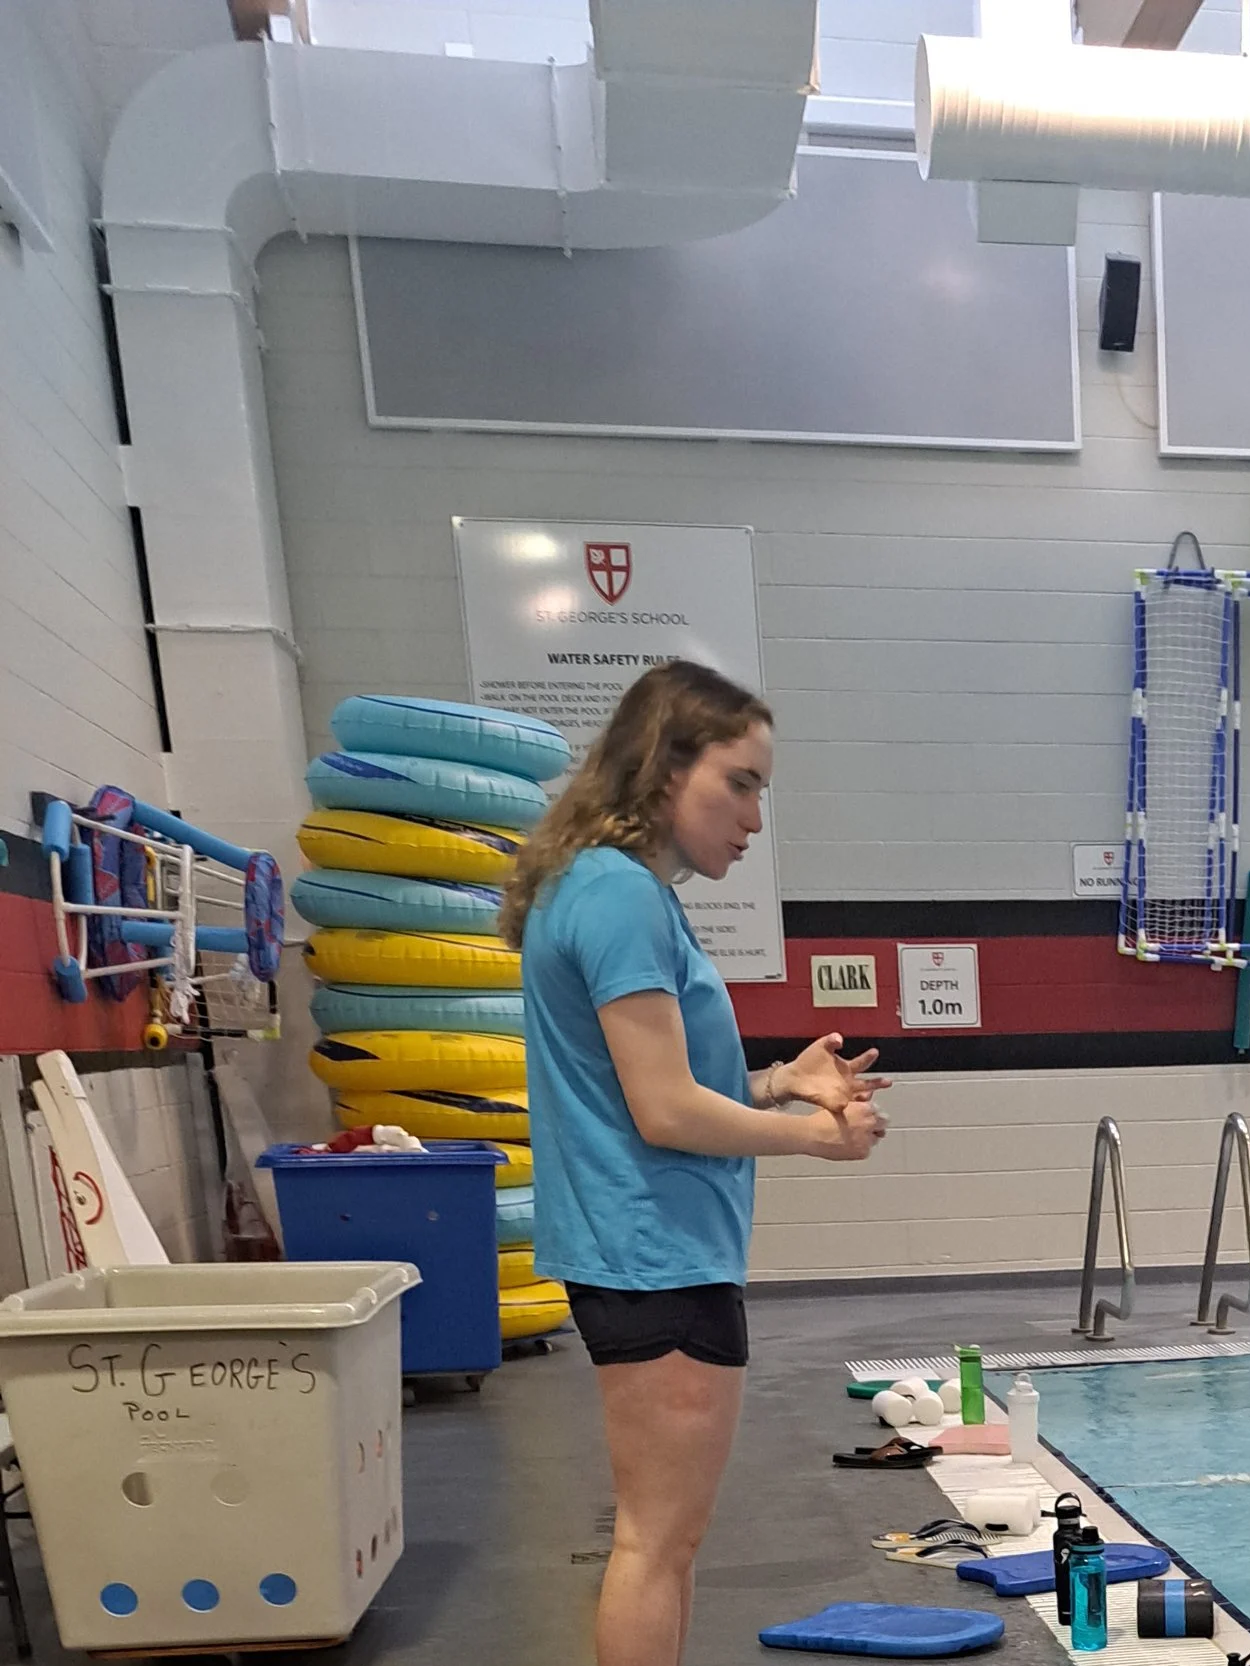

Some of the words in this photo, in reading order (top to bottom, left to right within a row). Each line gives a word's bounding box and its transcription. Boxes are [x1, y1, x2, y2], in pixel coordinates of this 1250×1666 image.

[558, 611, 628, 625] GEORGE'S
[632, 612, 690, 626] SCHOOL
[548, 653, 591, 665] WATER
[594, 654, 640, 666] SAFETY
[1079, 878, 1094, 887] NO
[817, 964, 872, 991] CLARK
[920, 980, 959, 991] DEPTH
[918, 999, 963, 1016] 1.0m
[68, 1343, 126, 1393] ST.
[122, 1402, 191, 1421] POOL
